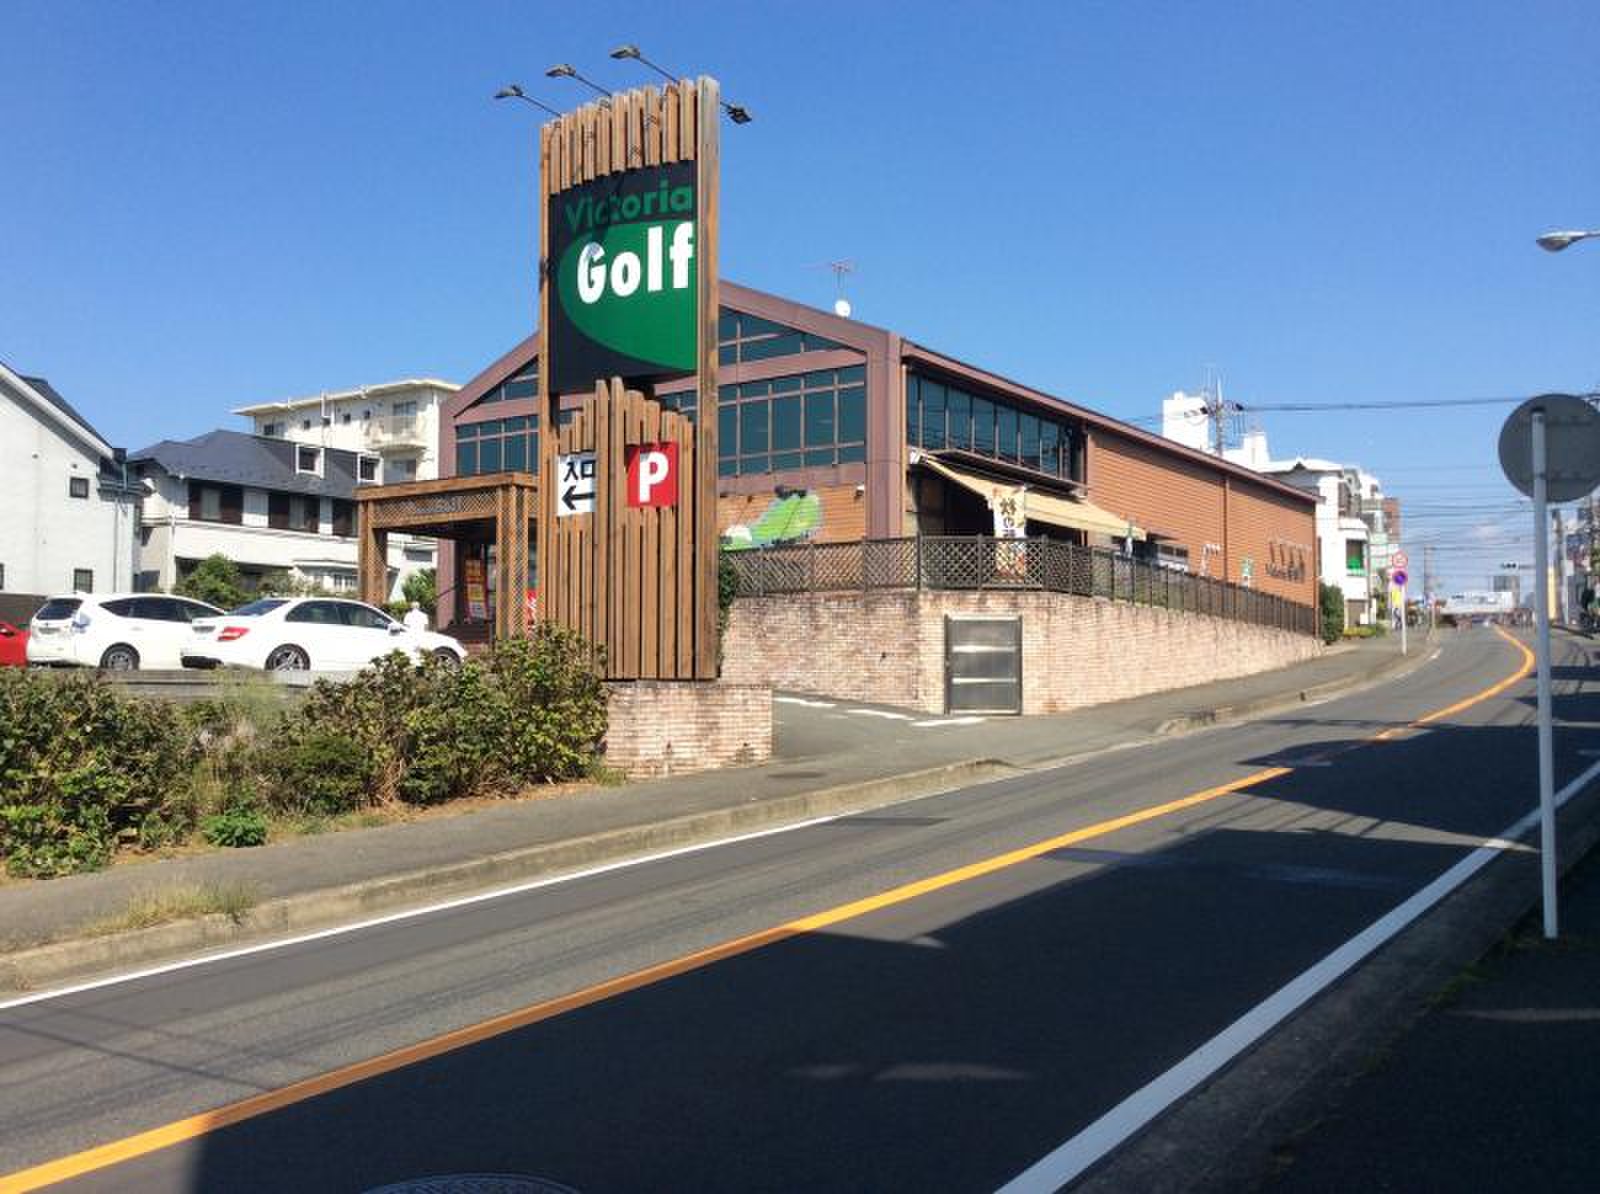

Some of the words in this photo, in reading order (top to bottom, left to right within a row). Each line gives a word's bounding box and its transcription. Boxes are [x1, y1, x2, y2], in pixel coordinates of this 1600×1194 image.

[564, 178, 693, 226] Victoria
[577, 221, 693, 303] Golf
[563, 459, 596, 482] 入口
[639, 451, 669, 503] P
